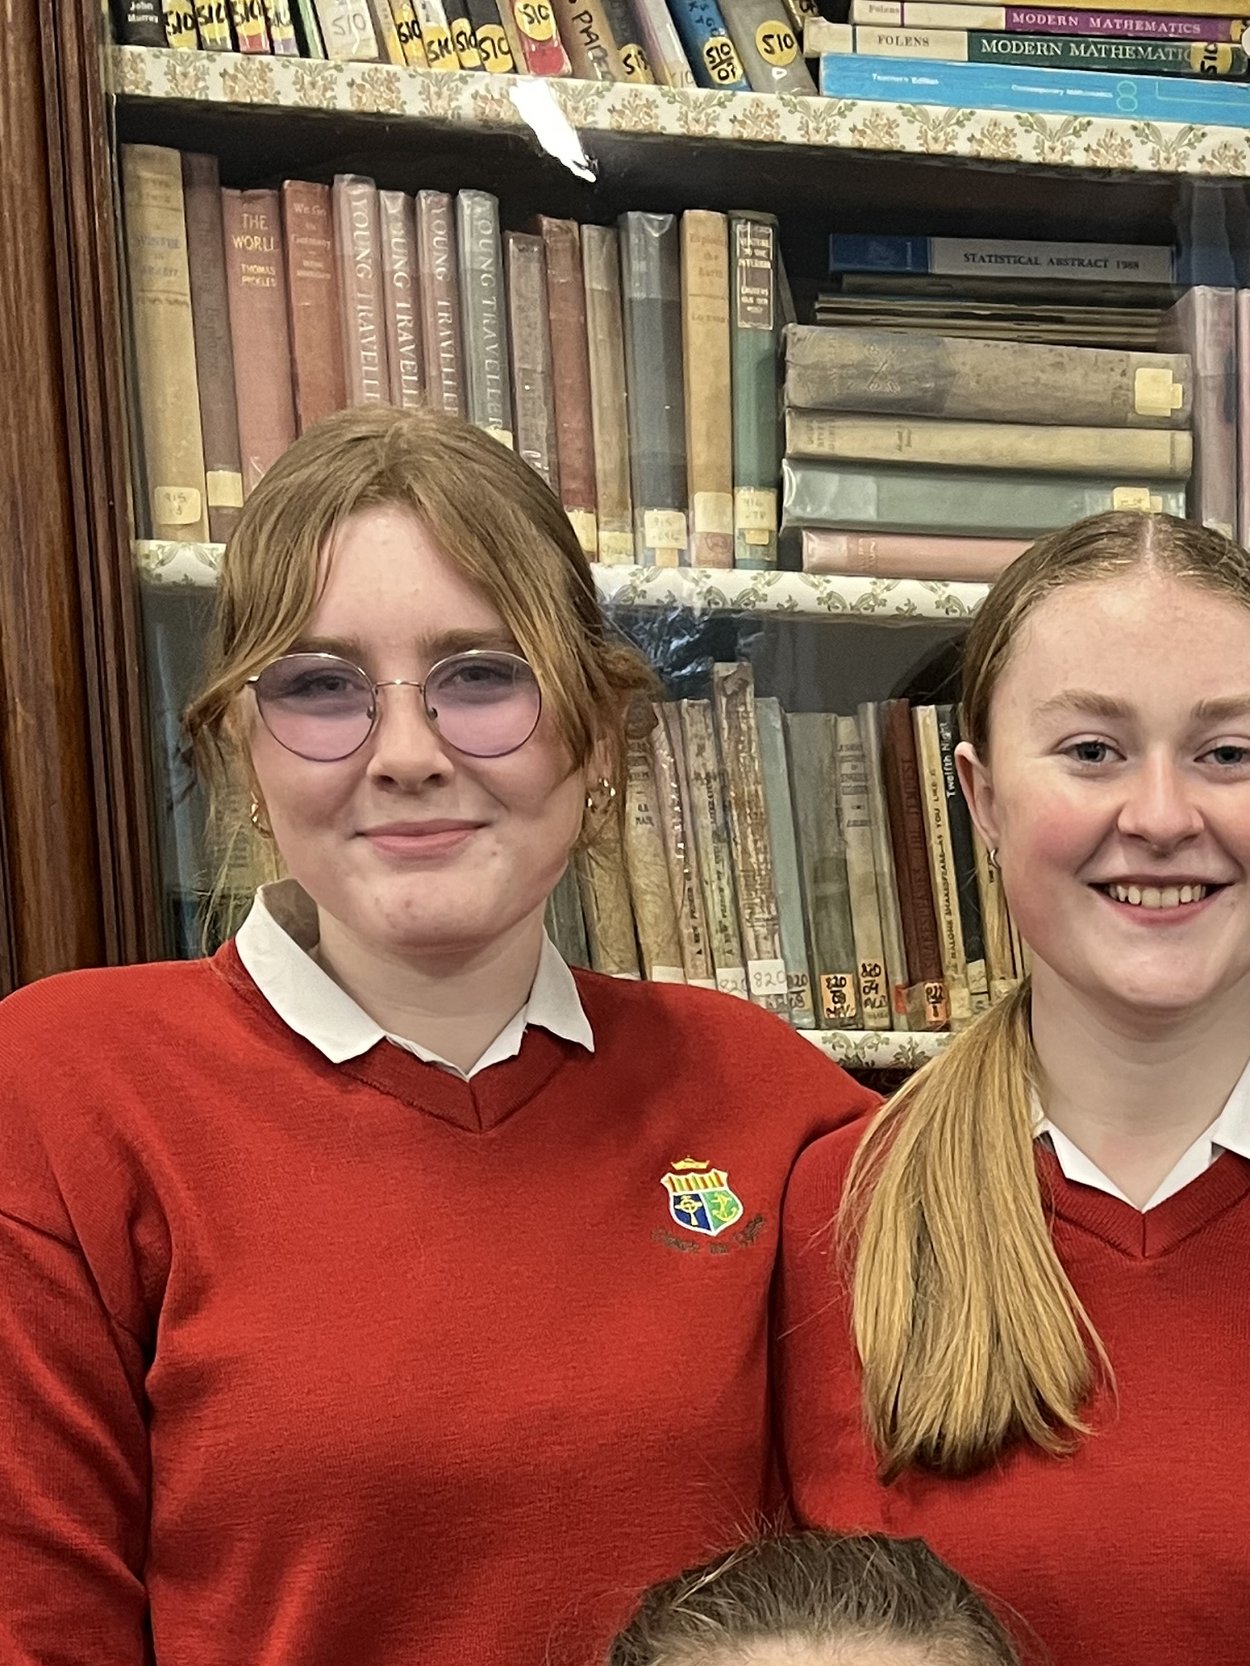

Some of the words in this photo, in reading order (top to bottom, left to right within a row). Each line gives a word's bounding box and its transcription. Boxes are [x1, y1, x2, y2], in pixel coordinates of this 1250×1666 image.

[130, 1, 154, 11] John
[868, 4, 900, 14] Folens
[1012, 12, 1079, 27] MODERN
[1089, 17, 1201, 34] MATHEMATICS
[762, 33, 796, 56] 510
[876, 34, 930, 47] FOLENS
[981, 38, 1062, 56] MODERN
[1069, 42, 1193, 62] MATHEMATIC
[1116, 80, 1138, 112] 8
[241, 212, 269, 231] THE
[430, 206, 451, 282] YOUNG
[963, 252, 1040, 266] STATISTICAL
[1049, 256, 1109, 270] ABSTRACT
[939, 722, 953, 752] Night
[943, 755, 957, 799] Twelfth
[930, 779, 940, 804] LIKE
[933, 808, 943, 829] YOU
[753, 970, 786, 988] 820
